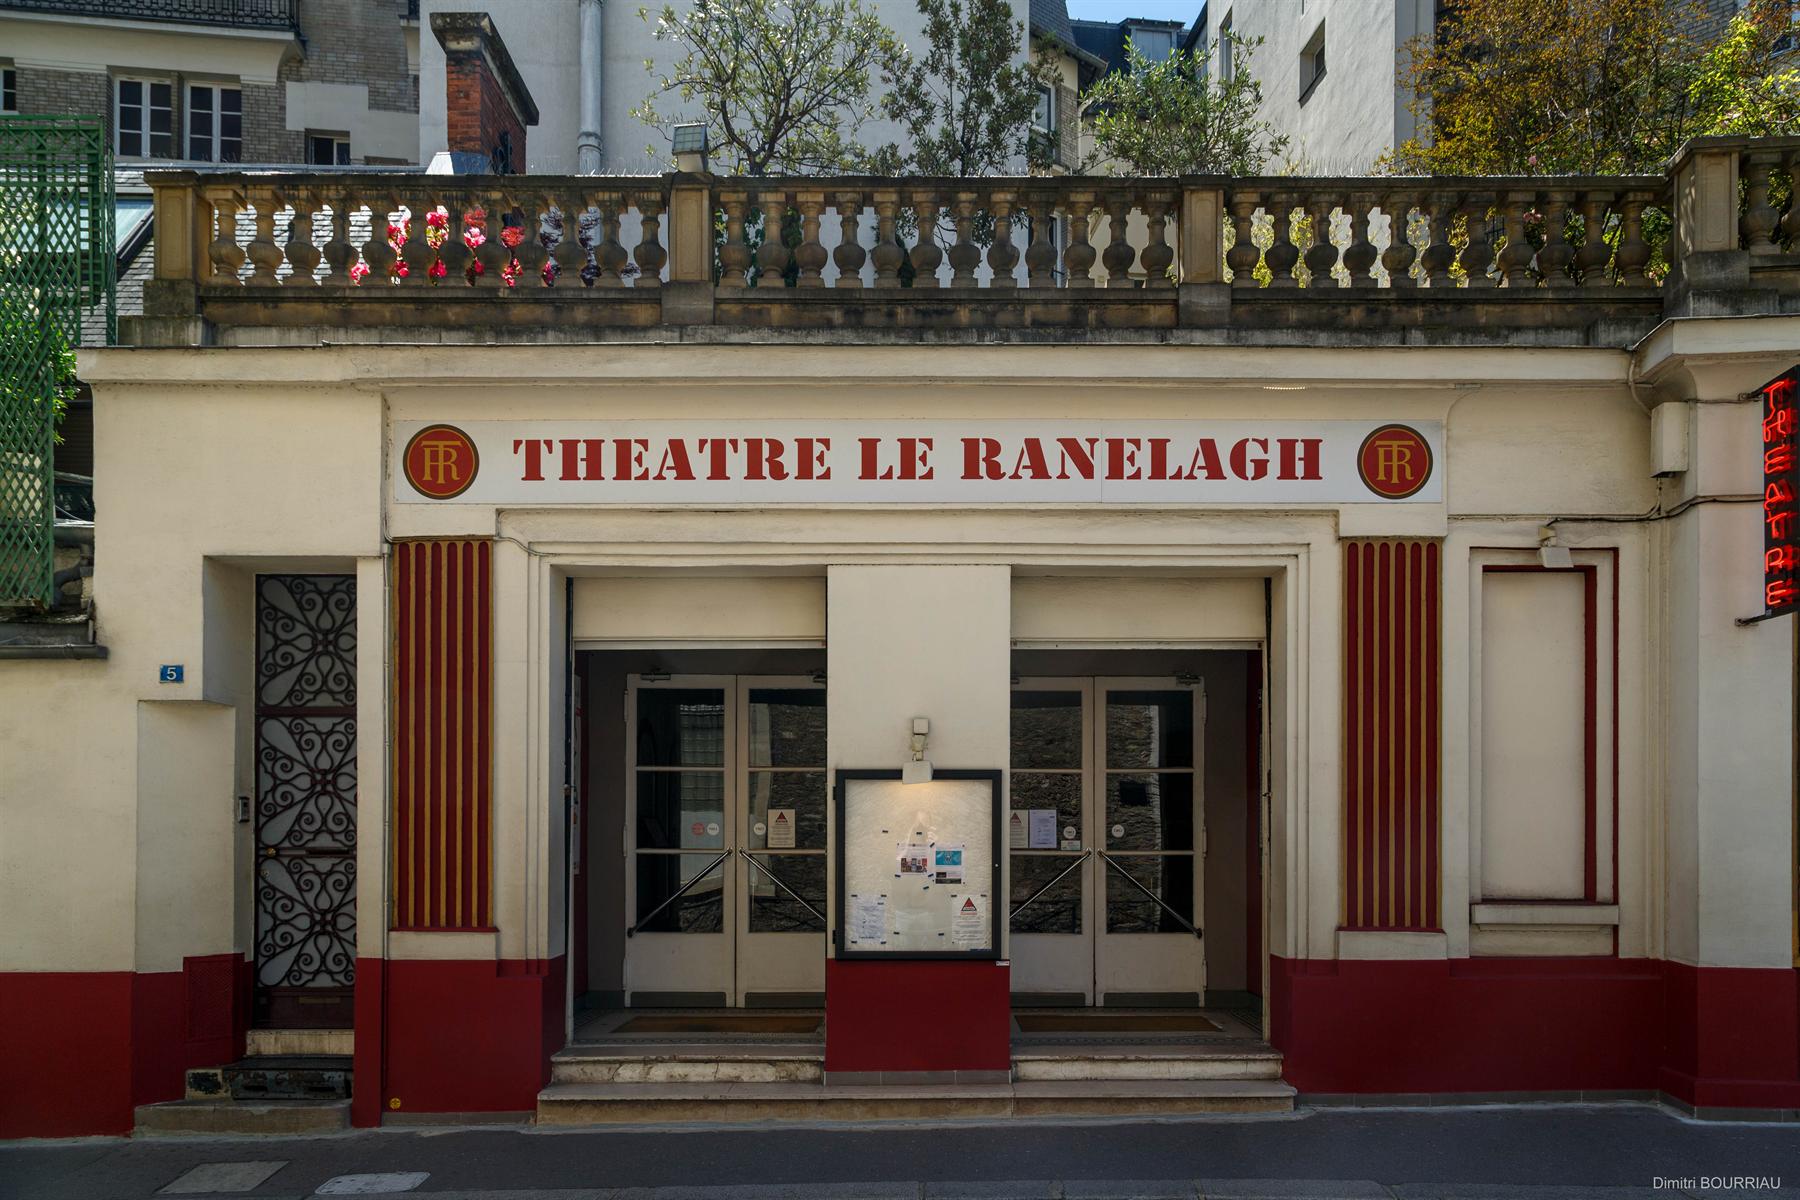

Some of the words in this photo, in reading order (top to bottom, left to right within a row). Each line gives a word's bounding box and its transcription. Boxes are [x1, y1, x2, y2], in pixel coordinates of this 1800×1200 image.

[513, 437, 831, 481] THEATRE
[859, 437, 934, 481] LE
[961, 437, 1322, 481] RANELAGH
[1763, 379, 1792, 607] THEATRE
[166, 667, 177, 680] 5
